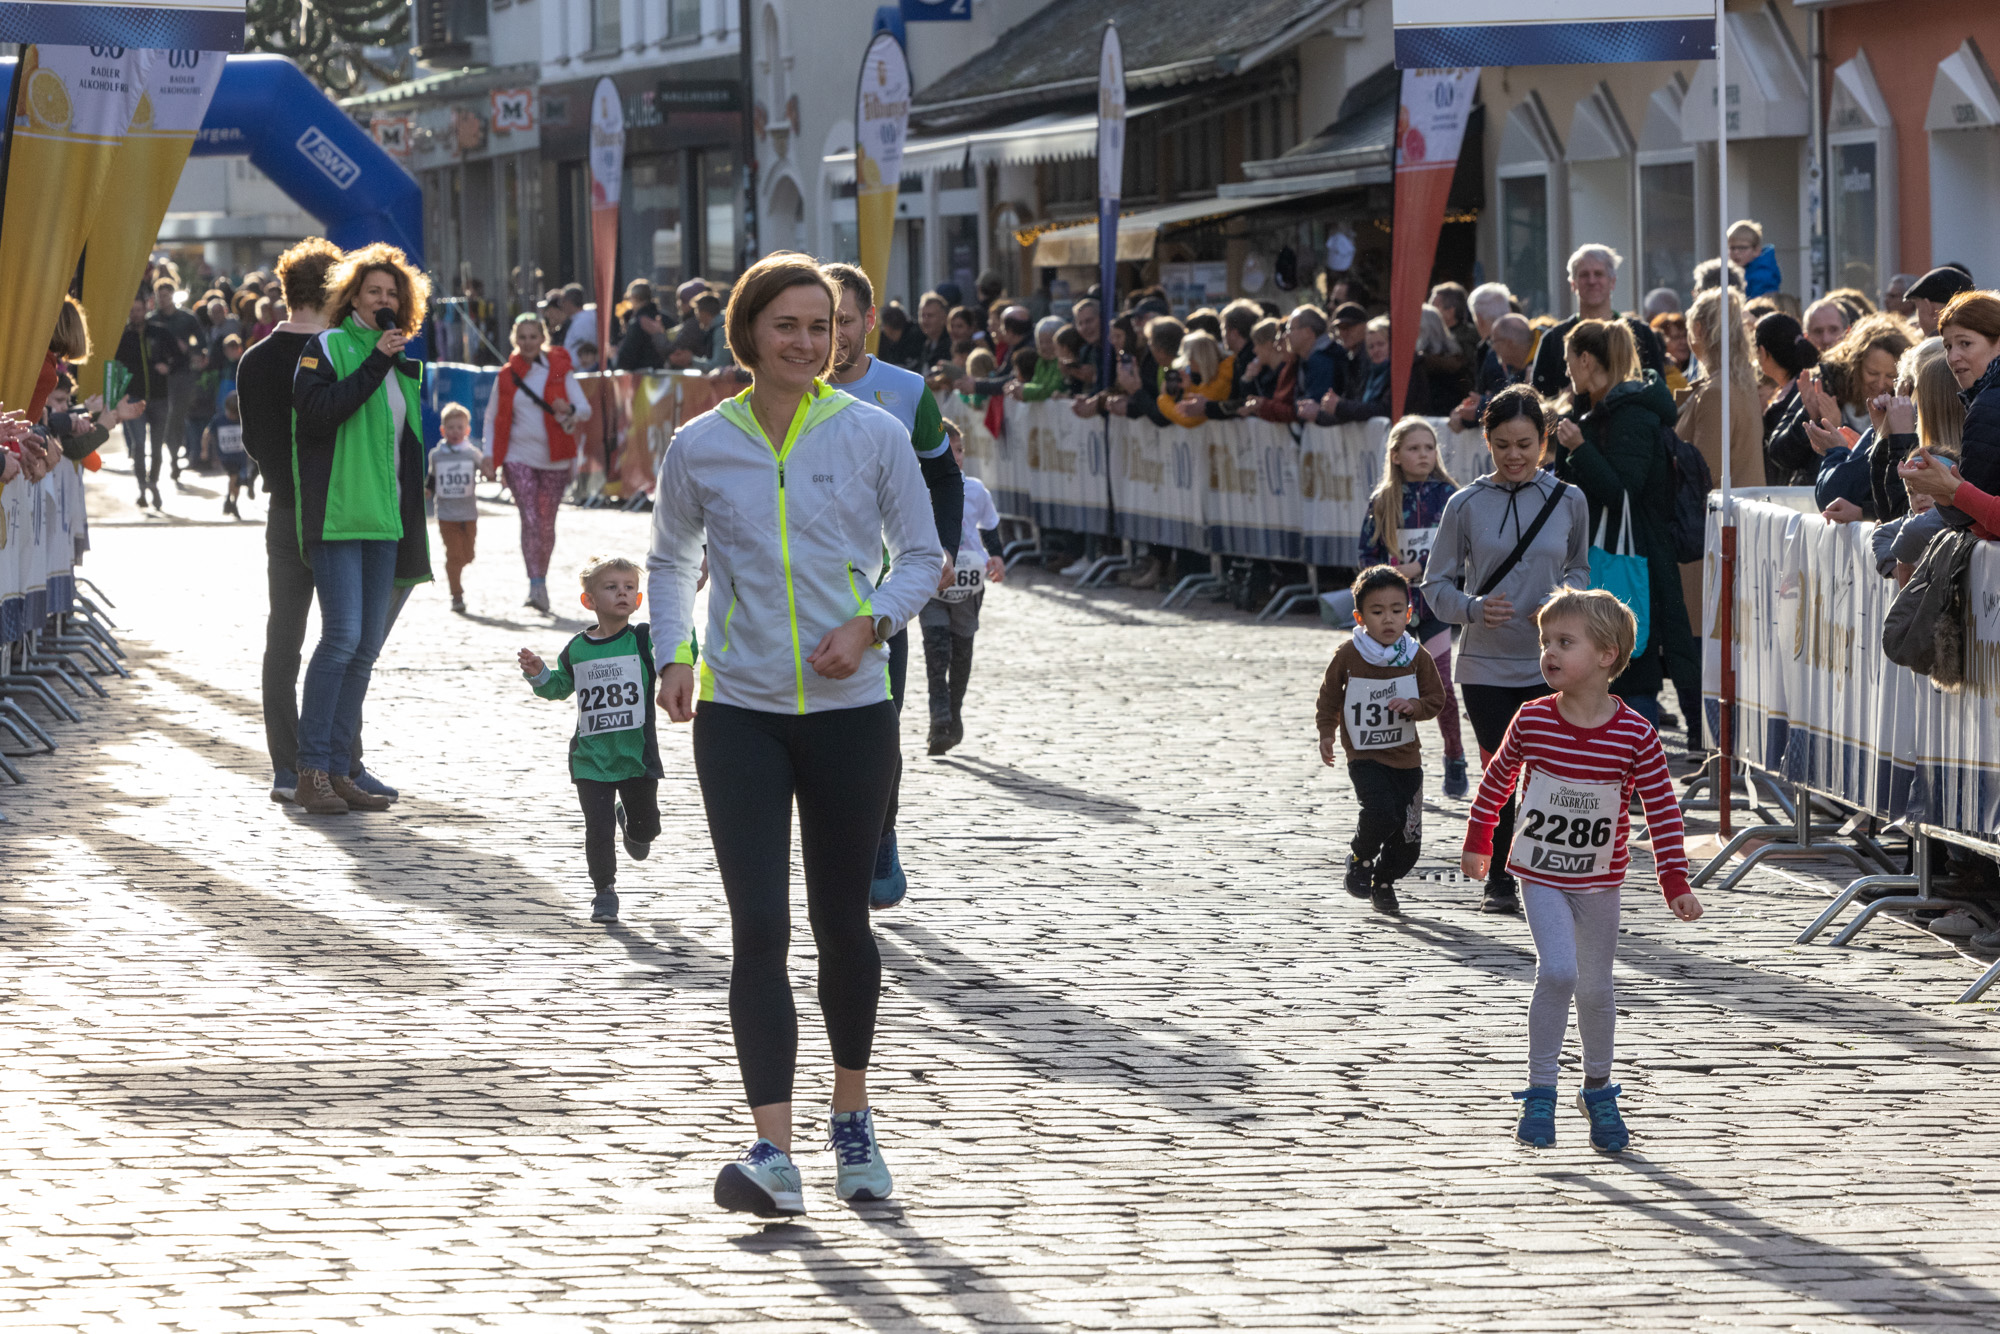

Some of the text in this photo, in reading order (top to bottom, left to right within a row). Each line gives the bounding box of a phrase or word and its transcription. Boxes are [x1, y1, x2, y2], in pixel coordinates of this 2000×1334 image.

[90, 66, 120, 79] RADLER
[503, 101, 522, 120] M
[439, 473, 470, 486] 1303
[812, 474, 834, 484] GORE
[588, 667, 624, 680] FASSBRAUSE
[580, 682, 639, 712] 2283
[1370, 681, 1397, 700] Kandi
[599, 713, 630, 727] SWT
[1371, 730, 1400, 743] SWT
[1559, 786, 1595, 798] Bitburger
[1550, 793, 1600, 809] FASSBRAUSE
[1523, 809, 1612, 849] 2286
[1547, 854, 1592, 871] SWT
